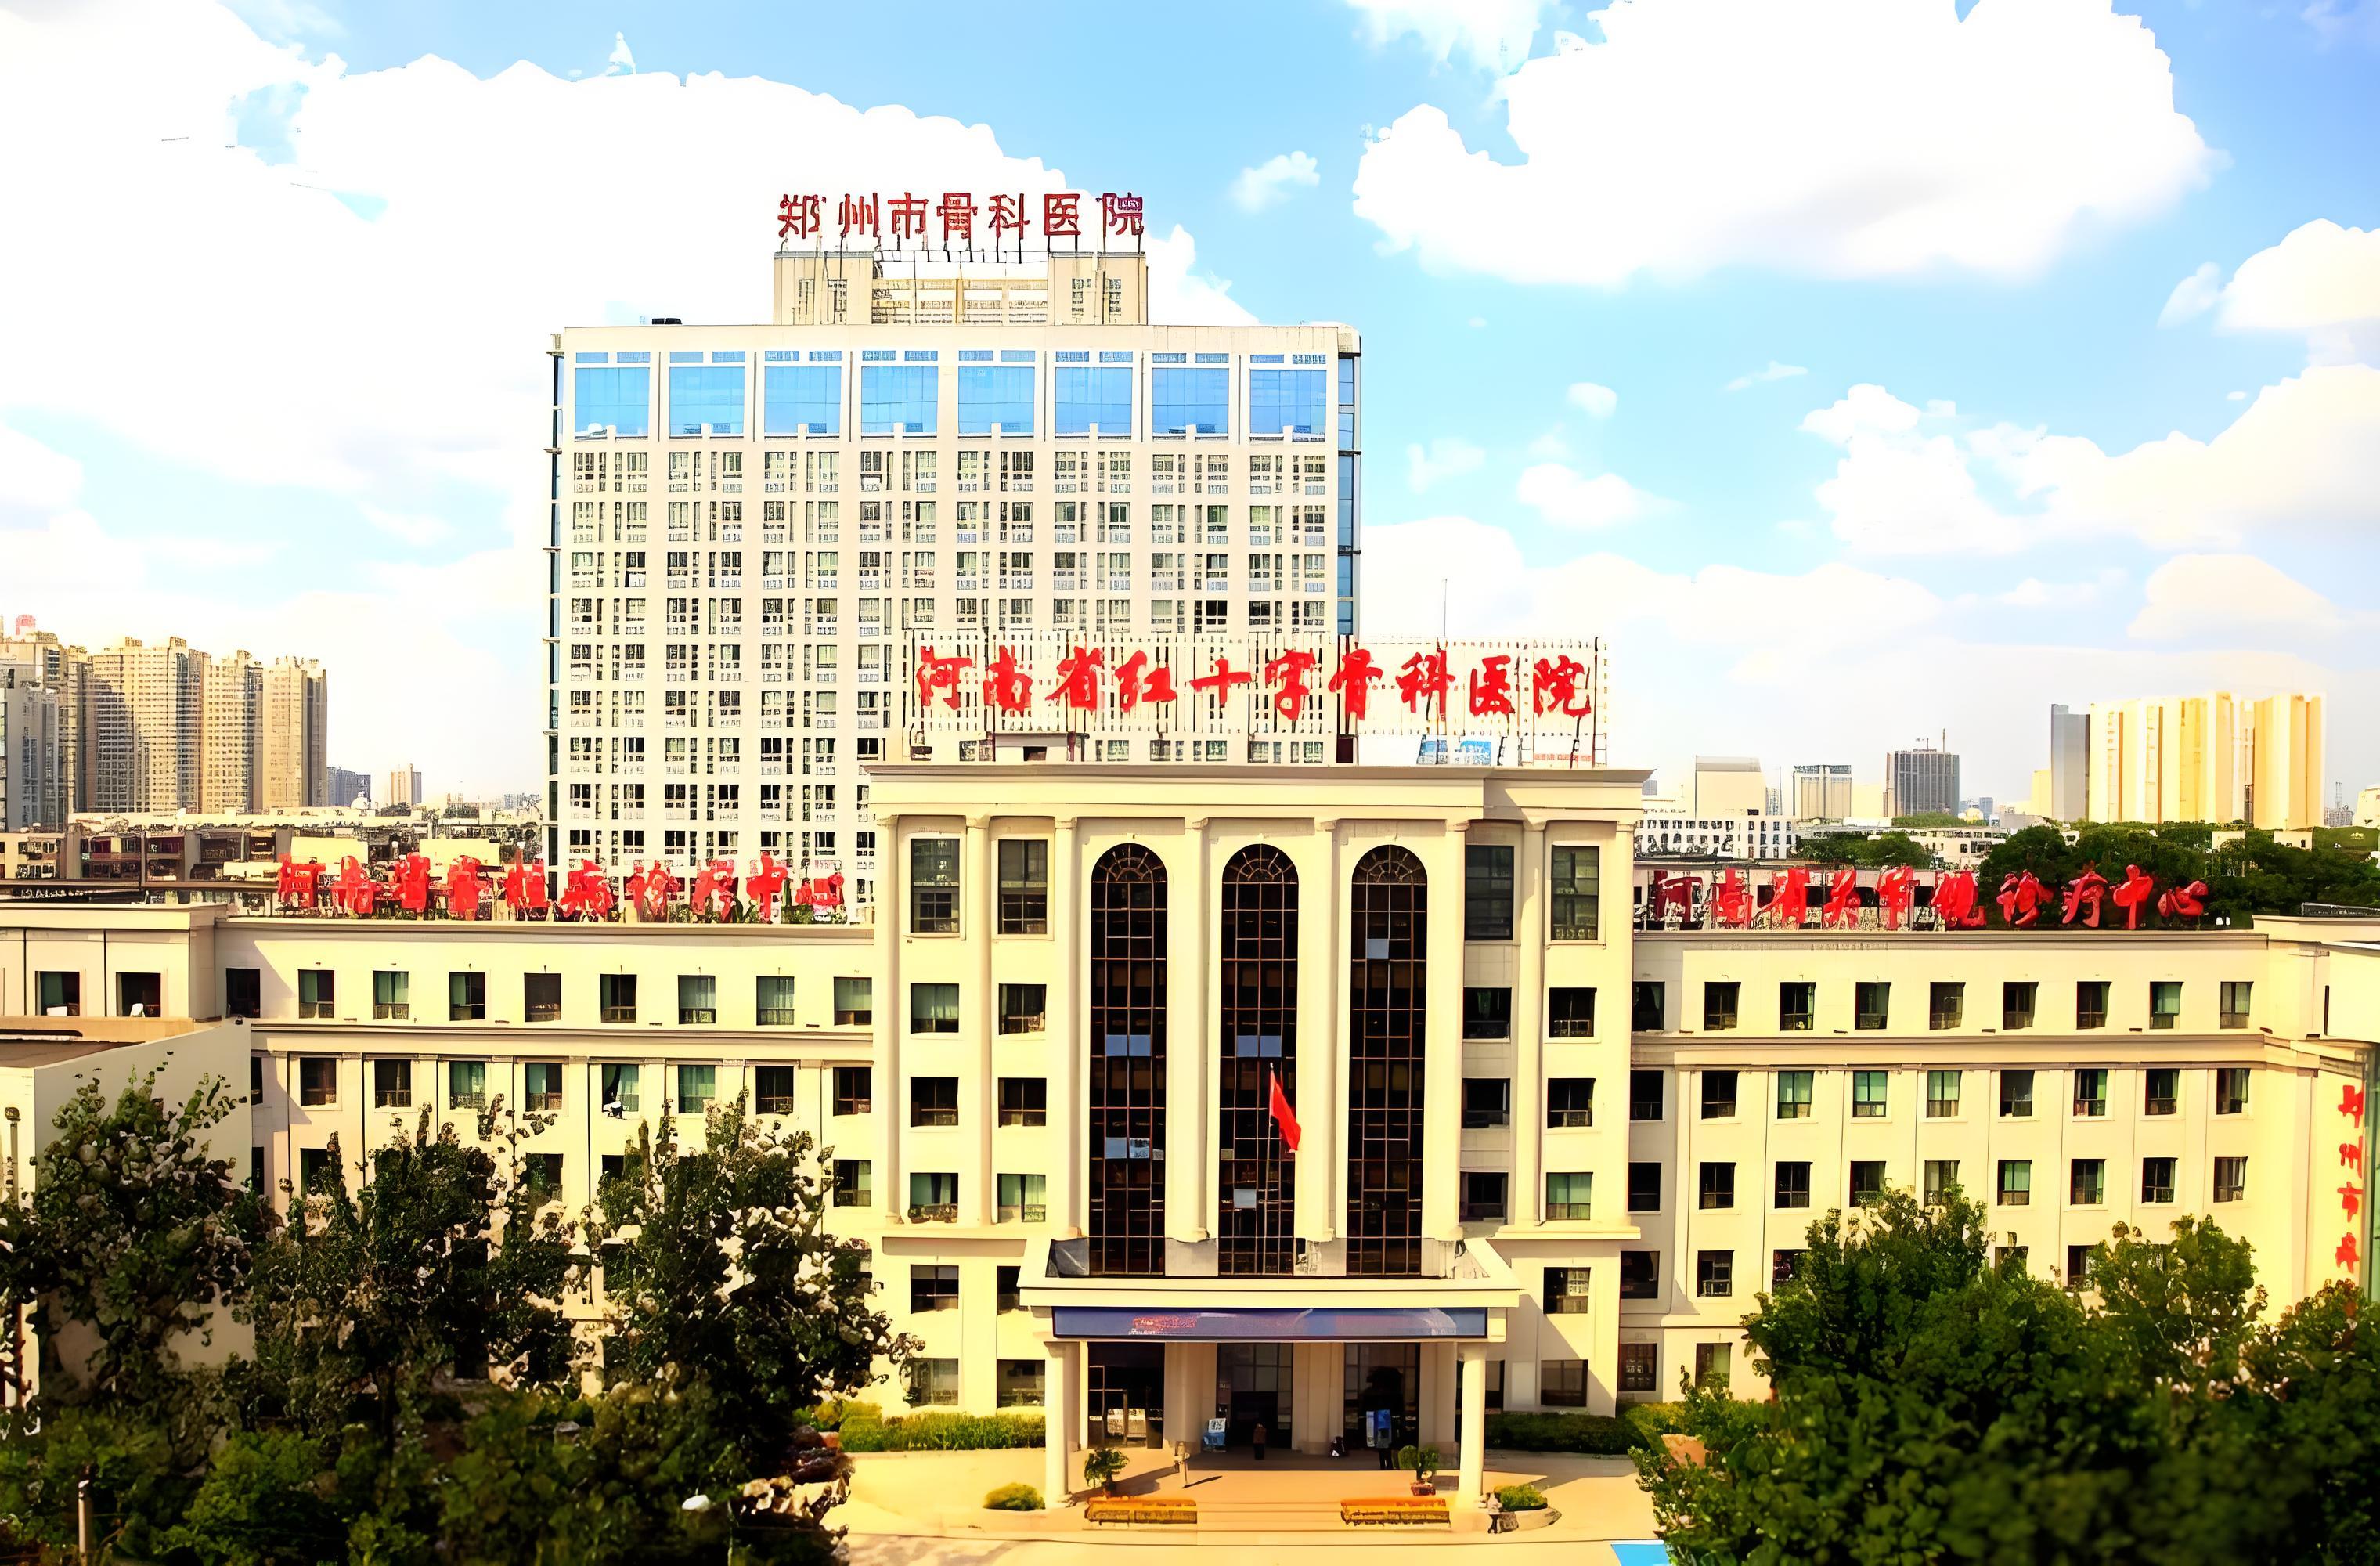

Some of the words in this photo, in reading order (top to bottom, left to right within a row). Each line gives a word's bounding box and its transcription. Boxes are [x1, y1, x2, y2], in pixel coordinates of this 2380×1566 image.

[777, 192, 1145, 240] 郑州市骨科医院
[917, 644, 1592, 720] 河南省红十字骨科医院
